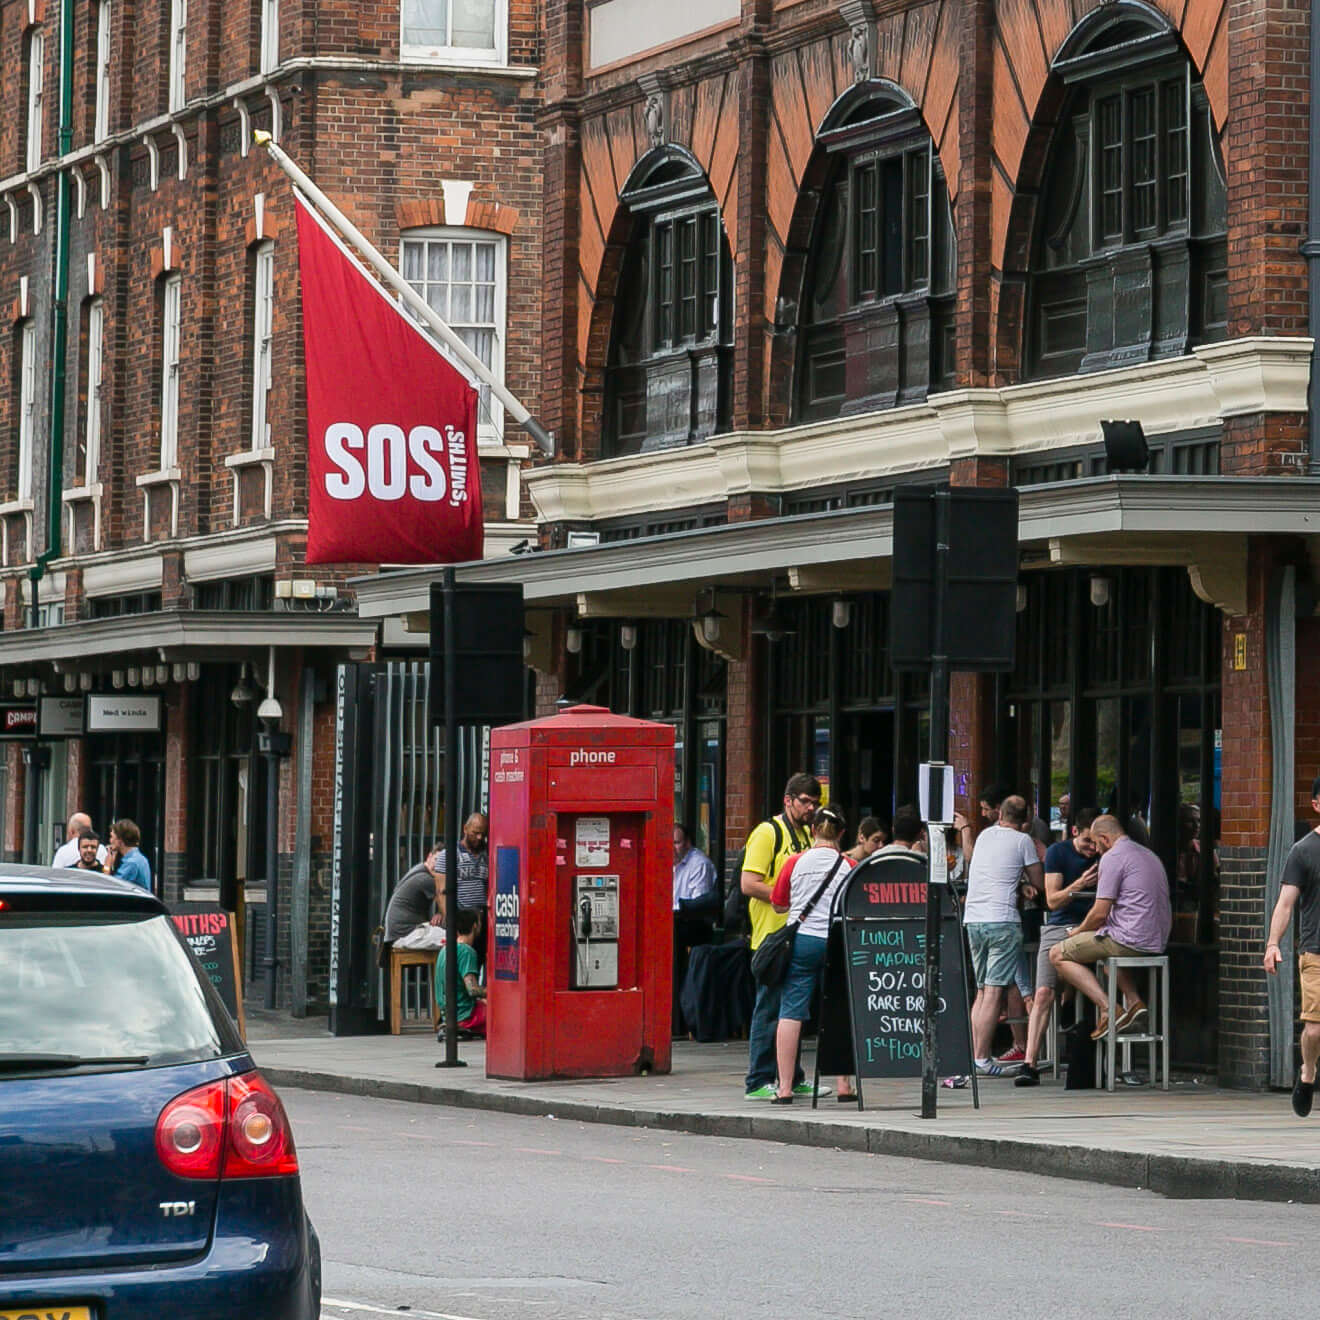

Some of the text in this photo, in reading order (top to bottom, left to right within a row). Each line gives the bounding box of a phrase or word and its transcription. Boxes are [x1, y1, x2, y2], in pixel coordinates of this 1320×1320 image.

[324, 422, 447, 502] SOS
[570, 747, 617, 767] phone
[496, 884, 519, 918] cash
[860, 929, 905, 949] LUNCH
[868, 971, 907, 992] 50%
[867, 994, 901, 1012] RARE
[159, 1201, 196, 1217] TDI
